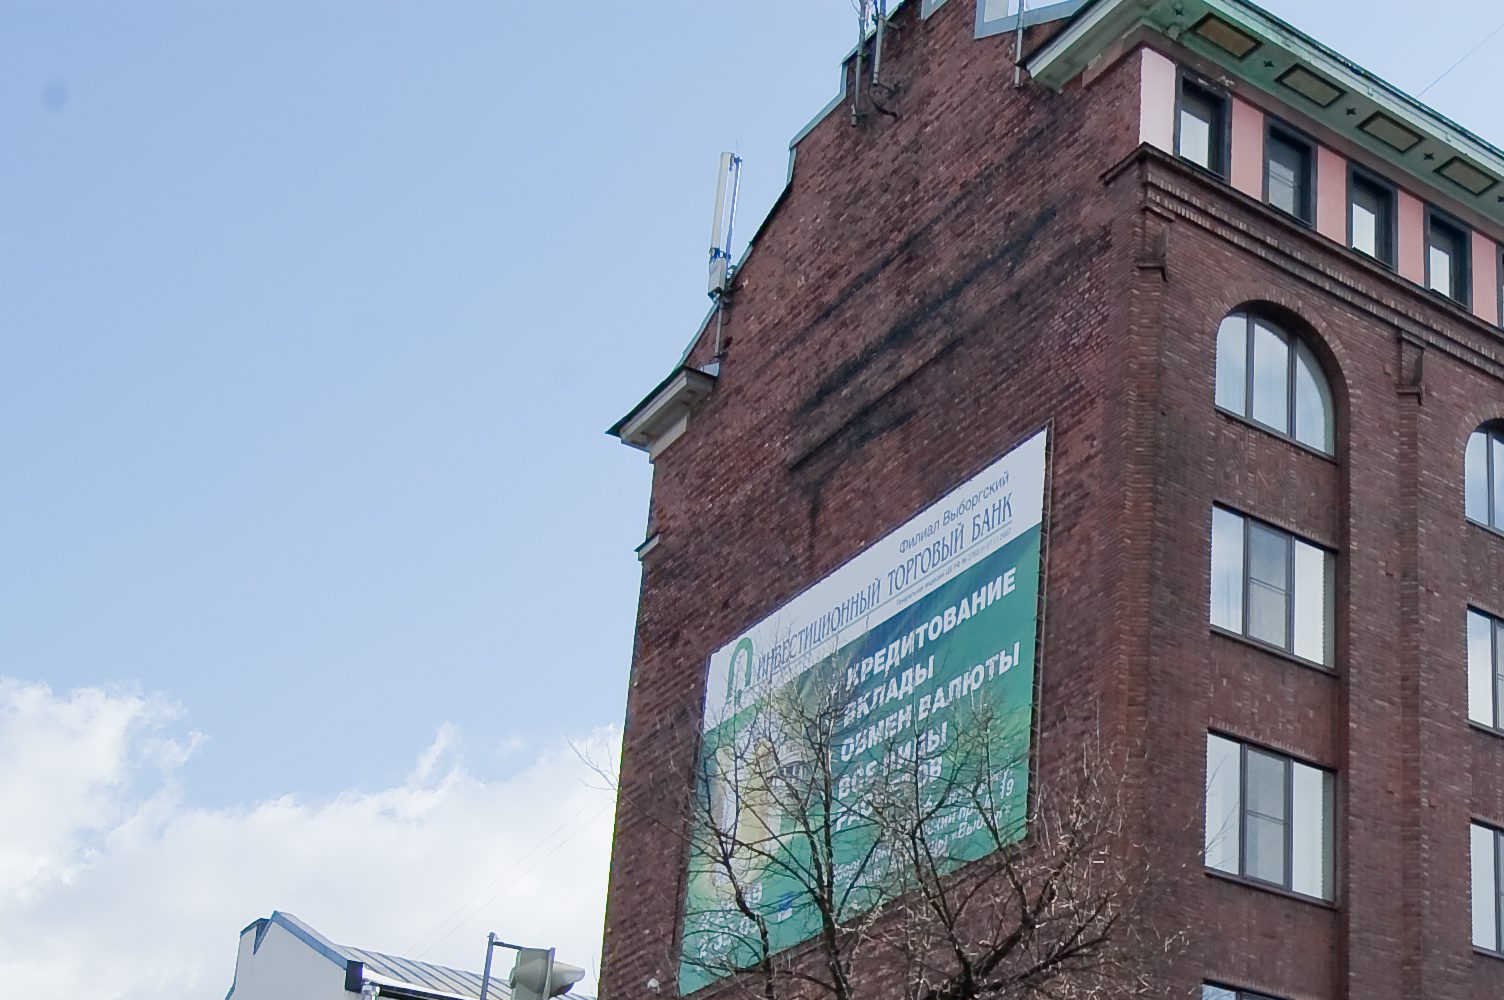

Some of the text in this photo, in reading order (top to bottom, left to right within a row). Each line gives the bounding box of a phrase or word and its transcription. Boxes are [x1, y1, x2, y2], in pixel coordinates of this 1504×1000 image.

[900, 470, 1010, 554] Филиал Выборгский
[757, 491, 1013, 683] ИНВЕСТИЦИОННЫЙ ТОРГОВЫЙ БАНК
[846, 566, 1017, 691] КРЕДИТОВАНИЕ
[840, 641, 1021, 762] ОБМЕН ВАЛЮТЫ
[843, 655, 935, 728] ВКЛАДЫ
